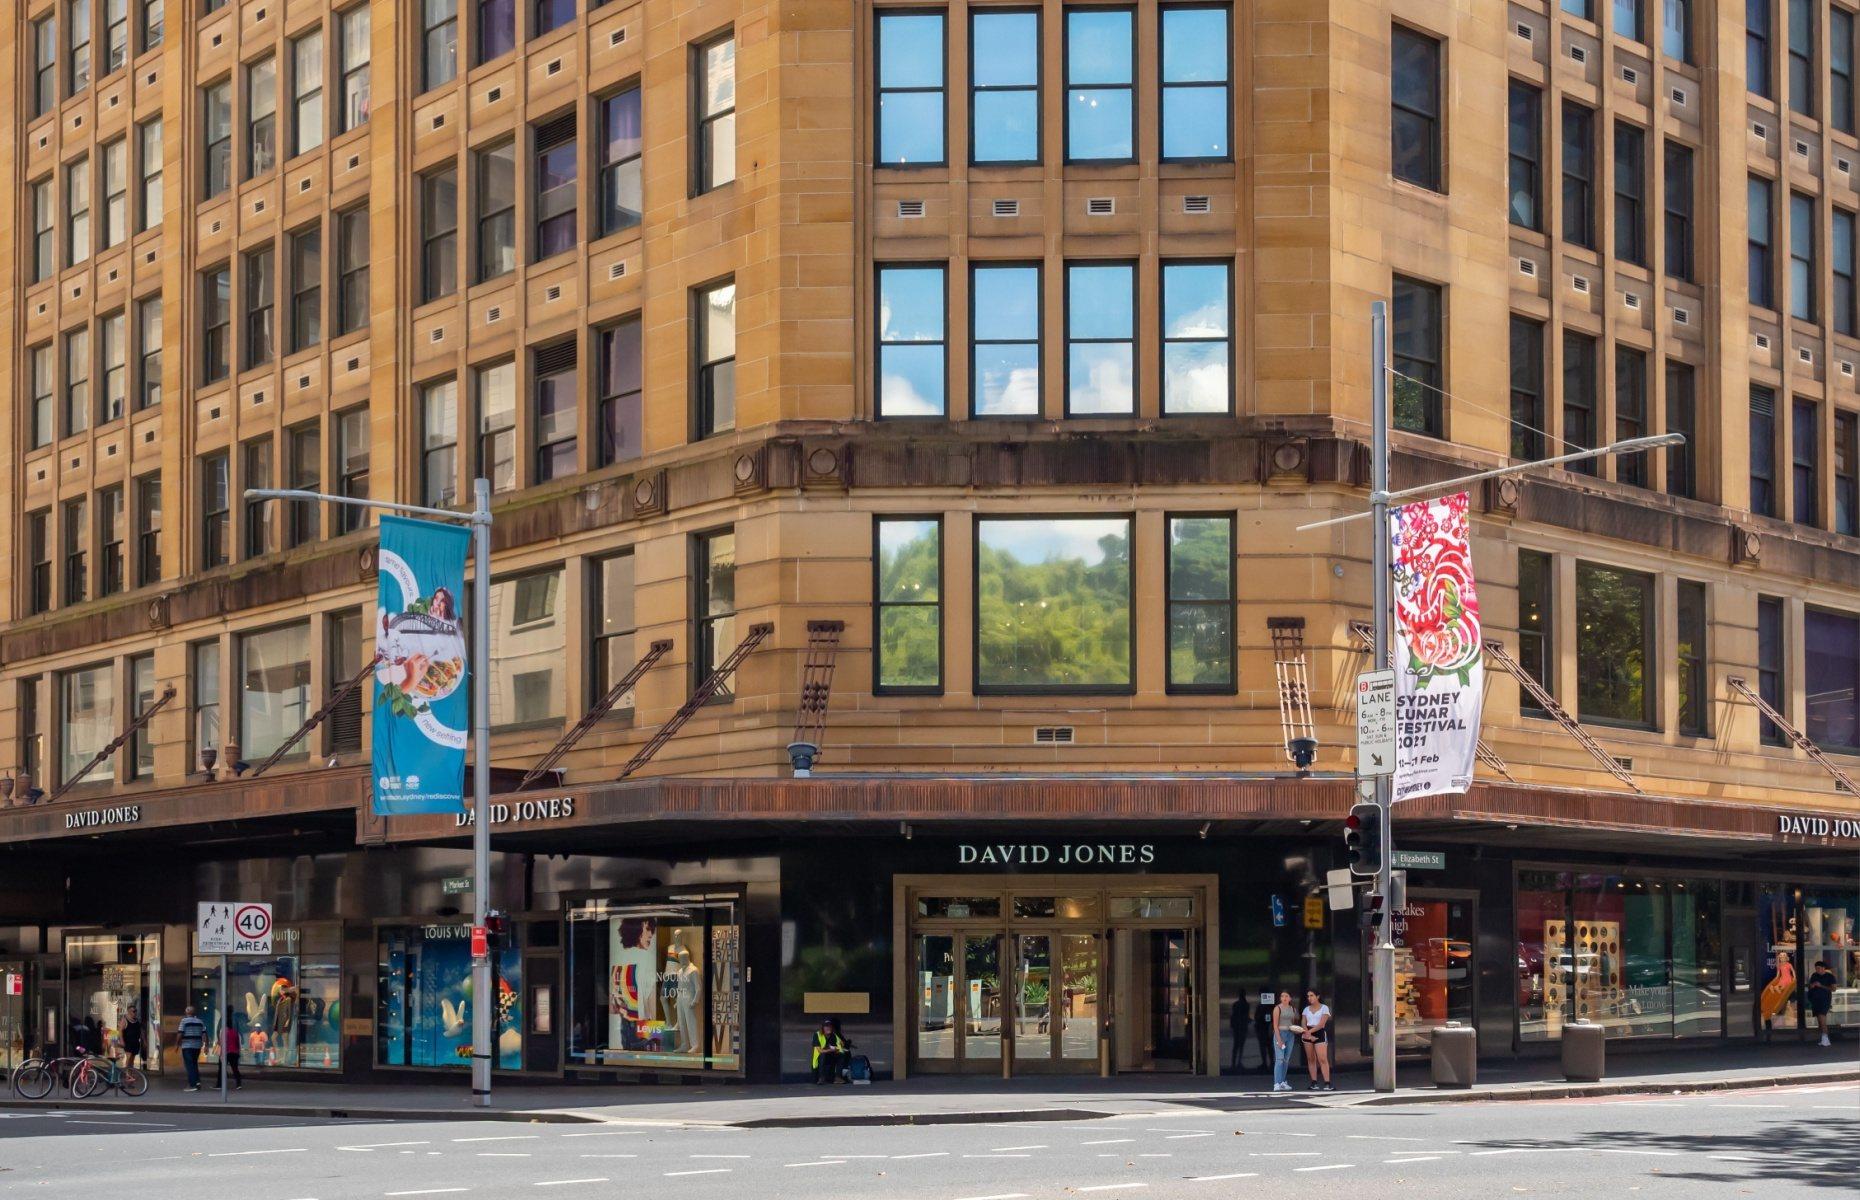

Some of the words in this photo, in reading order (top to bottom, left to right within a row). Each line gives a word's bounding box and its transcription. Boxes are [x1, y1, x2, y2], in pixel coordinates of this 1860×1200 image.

[1361, 692, 1391, 705] LANE
[1396, 692, 1460, 707] SYDNEY
[1396, 707, 1448, 720] LUNAR
[1398, 719, 1466, 735] FESTIVAL
[1399, 735, 1426, 749] 2021
[1421, 754, 1439, 764] Feb
[65, 810, 99, 828] DAVID
[101, 806, 139, 825] JONES
[456, 804, 508, 826] DAID
[513, 797, 572, 821] JONES
[1780, 815, 1829, 836] DAVID
[959, 845, 1049, 864] DAVID
[1058, 845, 1155, 864] JONES
[1400, 854, 1431, 864] Elizabeth
[1432, 855, 1439, 864] St
[449, 881, 464, 889] Market
[240, 914, 266, 930] 40
[425, 927, 451, 938] LOUIS
[236, 941, 269, 951] AREA
